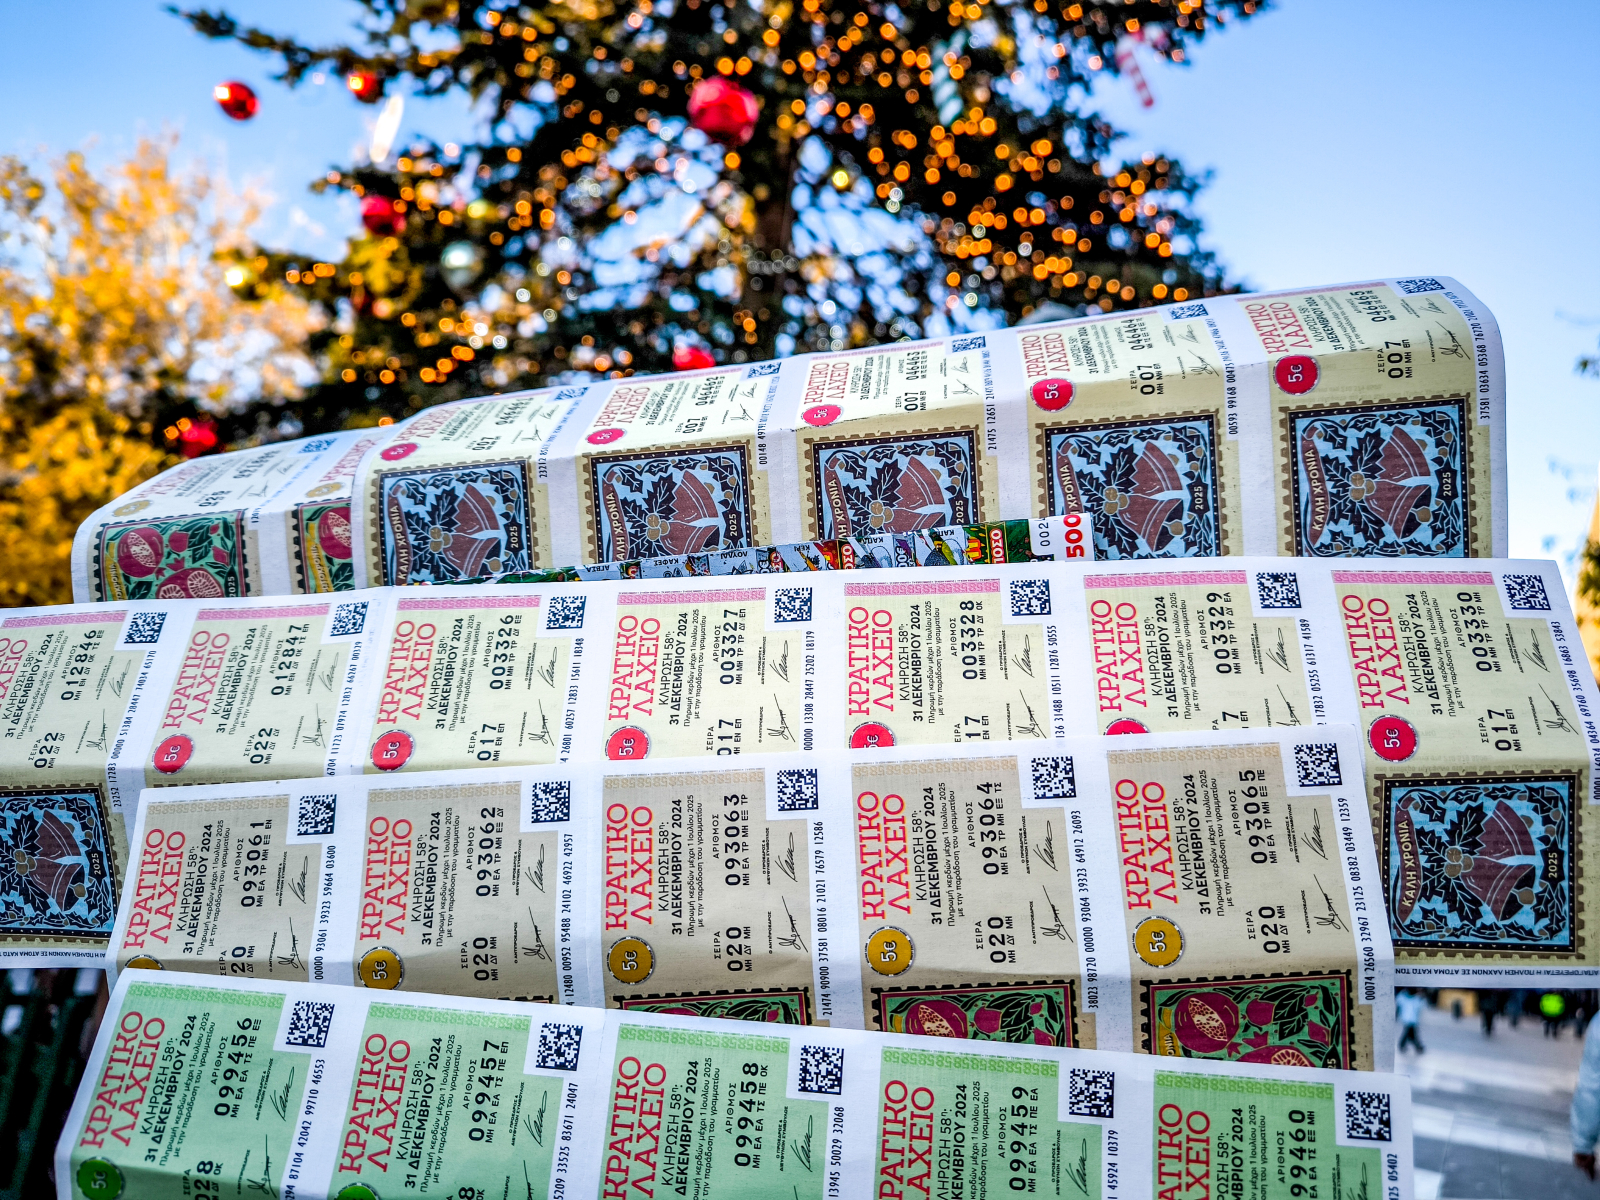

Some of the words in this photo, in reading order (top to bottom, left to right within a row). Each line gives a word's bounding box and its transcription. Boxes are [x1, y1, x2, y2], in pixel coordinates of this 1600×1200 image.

[1269, 301, 1313, 350] ΛΑΧΕΙΟ
[1349, 290, 1387, 323] 046465
[1244, 303, 1289, 355] ΚΡΑΤΙΚΟ
[1021, 335, 1048, 379] ΚΡΑΤΙΚΟ
[1042, 333, 1071, 372] ΛΑΧΕΙΟ
[1287, 364, 1303, 383] 5€
[1377, 347, 1385, 373] ΣΕΙΡΑ
[1385, 340, 1403, 379] 007
[1477, 344, 1489, 367] 05368
[803, 362, 830, 405] ΚΡΑΤΙΚΟ
[826, 361, 850, 400] ΛΑΧΕΙΟ
[904, 392, 919, 412] 007
[1137, 365, 1156, 396] 007
[1226, 387, 1237, 409] 99168
[1479, 370, 1489, 393] 03634
[682, 417, 701, 434] 007
[986, 403, 997, 425] 12651
[1228, 412, 1238, 435] 00593
[1480, 397, 1490, 420] 37581
[472, 437, 497, 451] 007
[759, 443, 767, 465] 00148
[987, 428, 997, 451] 21475
[539, 457, 548, 479] 23212
[1059, 464, 1079, 508] ΧΡΟΝΙΑ
[1304, 449, 1322, 498] ΧΡΟΝΙΑ
[1442, 472, 1452, 497] 2025
[607, 491, 624, 534] ΧΡΟΝΙΑ
[828, 478, 845, 523] ΧΡΟΝΙΑ
[1194, 486, 1205, 510] 2025
[1311, 499, 1325, 530] ΚΑΛΗ
[389, 504, 408, 550] ΧΡΟΝΙΑ
[510, 525, 519, 549] 2025
[1063, 514, 1085, 558] 500
[398, 550, 409, 580] ΚΑΛΗ
[910, 604, 921, 630] 2024
[1405, 593, 1421, 619] 2024
[489, 615, 514, 690] 003326
[720, 609, 738, 685] 003327
[806, 631, 815, 650] 18179
[959, 600, 978, 680] 003328
[1206, 592, 1232, 674] 003329
[1341, 594, 1385, 709] ΚΡΑΤΙΚΟ
[1367, 598, 1410, 705] ΛΑΧΕΙΟ
[1456, 592, 1493, 672] 003330
[60, 630, 97, 701] 012846
[270, 625, 302, 696] 012847
[376, 620, 415, 724] ΚΡΑΤΙΚΟ
[401, 623, 436, 720] ΛΑΧΕΙΟ
[608, 615, 639, 721] ΚΡΑΤΙΚΟ
[632, 618, 661, 716] ΛΑΧΕΙΟ
[805, 655, 815, 675] 25202
[848, 606, 870, 716] ΚΡΑΤΙΚΟ
[872, 609, 894, 712] ΛΑΧΕΙΟ
[898, 646, 910, 701] ΚΛΗΡΩΣΗ
[910, 632, 923, 707] ΔΕΚΕΜΒΡΙΟΥ
[1090, 599, 1122, 712] ΚΡΑΤΙΚΟ
[1115, 602, 1147, 708] ΛΑΧΕΙΟ
[1412, 622, 1440, 700] ΔΕΚΕΜΒΡΙΟΥ
[162, 630, 211, 729] ΚΡΑΤΙΚΟ
[186, 633, 230, 725] ΛΑΧΕΙΟ
[804, 679, 814, 700] 28447
[804, 703, 813, 724] 13308
[912, 711, 923, 722] 31
[1430, 703, 1443, 715] 31
[1487, 709, 1512, 751] 017
[35, 732, 59, 769] 022
[164, 745, 183, 762] 5€
[250, 728, 273, 764] 022
[477, 724, 497, 761] 017
[803, 728, 813, 751] 00000
[1383, 728, 1404, 748] 5€
[1199, 770, 1208, 789] 2025
[1211, 778, 1223, 822] γραμματίου
[671, 799, 682, 829] 2024
[1202, 790, 1212, 818] Ιουλίου
[1238, 770, 1268, 864] 093065
[724, 794, 741, 886] 093063
[813, 821, 824, 844] 12586
[976, 782, 1000, 875] 093064
[1115, 779, 1152, 910] ΚΡΑΤΙΚΟ
[1141, 782, 1178, 904] ΛΑΧΕΙΟ
[1207, 825, 1217, 846] μέχρι
[1398, 820, 1415, 870] ΧΡΟΝΙΑ
[93, 852, 102, 875] 2025
[240, 822, 264, 907] 093061
[475, 807, 496, 897] 093062
[605, 803, 628, 931] ΚΡΑΤΙΚΟ
[630, 806, 653, 925] ΛΑΧΕΙΟ
[814, 850, 825, 874] 76579
[857, 791, 885, 920] ΚΡΑΤΙΚΟ
[882, 794, 911, 914] ΛΑΧΕΙΟ
[912, 837, 928, 901] ΚΛΗΡΩΣΗ
[1209, 847, 1220, 877] κερδών
[1219, 839, 1230, 880] παράδοση
[1548, 851, 1558, 879] 2025
[125, 828, 165, 949] ΚΡΑΤΙΚΟ
[150, 831, 186, 944] ΛΑΧΕΙΟ
[359, 816, 390, 941] ΚΡΑΤΙΚΟ
[384, 819, 413, 935] ΛΑΧΕΙΟ
[671, 832, 682, 918] ΔΕΚΕΜΒΡΙΟΥ
[816, 880, 826, 903] 21021
[1224, 881, 1232, 895] την
[1402, 870, 1417, 907] ΚΑΛΗ
[817, 907, 827, 932] 08016
[1213, 879, 1225, 917] Πληρωμή
[1226, 897, 1235, 907] με
[671, 922, 682, 935] 31
[713, 931, 722, 960] ΣΕΙΡΑ
[726, 927, 743, 972] 020
[818, 938, 829, 962] 37581
[987, 917, 1007, 963] 020
[1148, 931, 1168, 953] 5€
[1258, 906, 1281, 954] 020
[228, 946, 248, 977] 20
[472, 937, 489, 981] 020
[622, 950, 638, 971] 5€
[1460, 968, 1471, 976] ΣΕ
[214, 1018, 252, 1116] 099456
[427, 1037, 442, 1070] 2024
[80, 1011, 143, 1149] ΚΡΑΤΙΚΟ
[110, 1017, 165, 1147] ΛΑΧΕΙΟ
[468, 1040, 500, 1141] 099457
[338, 1033, 387, 1175] ΚΡΑΤΙΚΟ
[367, 1040, 411, 1173] ΛΑΧΕΙΟ
[395, 1089, 420, 1160] ΚΛΗΡΩΣΗ
[408, 1073, 436, 1170] ΔΕΚΕΜΒΡΙΟΥ
[725, 1083, 737, 1135] ΑΡΙΘΜΟΣ
[734, 1062, 759, 1167] 099458
[832, 1106, 844, 1134] 32068
[602, 1056, 641, 1200] ΚΡΑΤΙΚΟ
[631, 1063, 667, 1199] ΛΑΧΕΙΟ
[674, 1097, 695, 1196] ΔΕΚΕΜΒΡΙΟΥ
[685, 1060, 699, 1094] 2024
[878, 1080, 908, 1200] ΡΑΤΙΚΟ
[905, 1087, 935, 1200] ΑΧΕΙΟ
[1009, 1086, 1029, 1191] 099459
[830, 1138, 842, 1166] 50029
[1156, 1103, 1184, 1200] ΑΤΙΚΟ
[1288, 1110, 1308, 1197] 99460
[404, 1174, 417, 1189] 31
